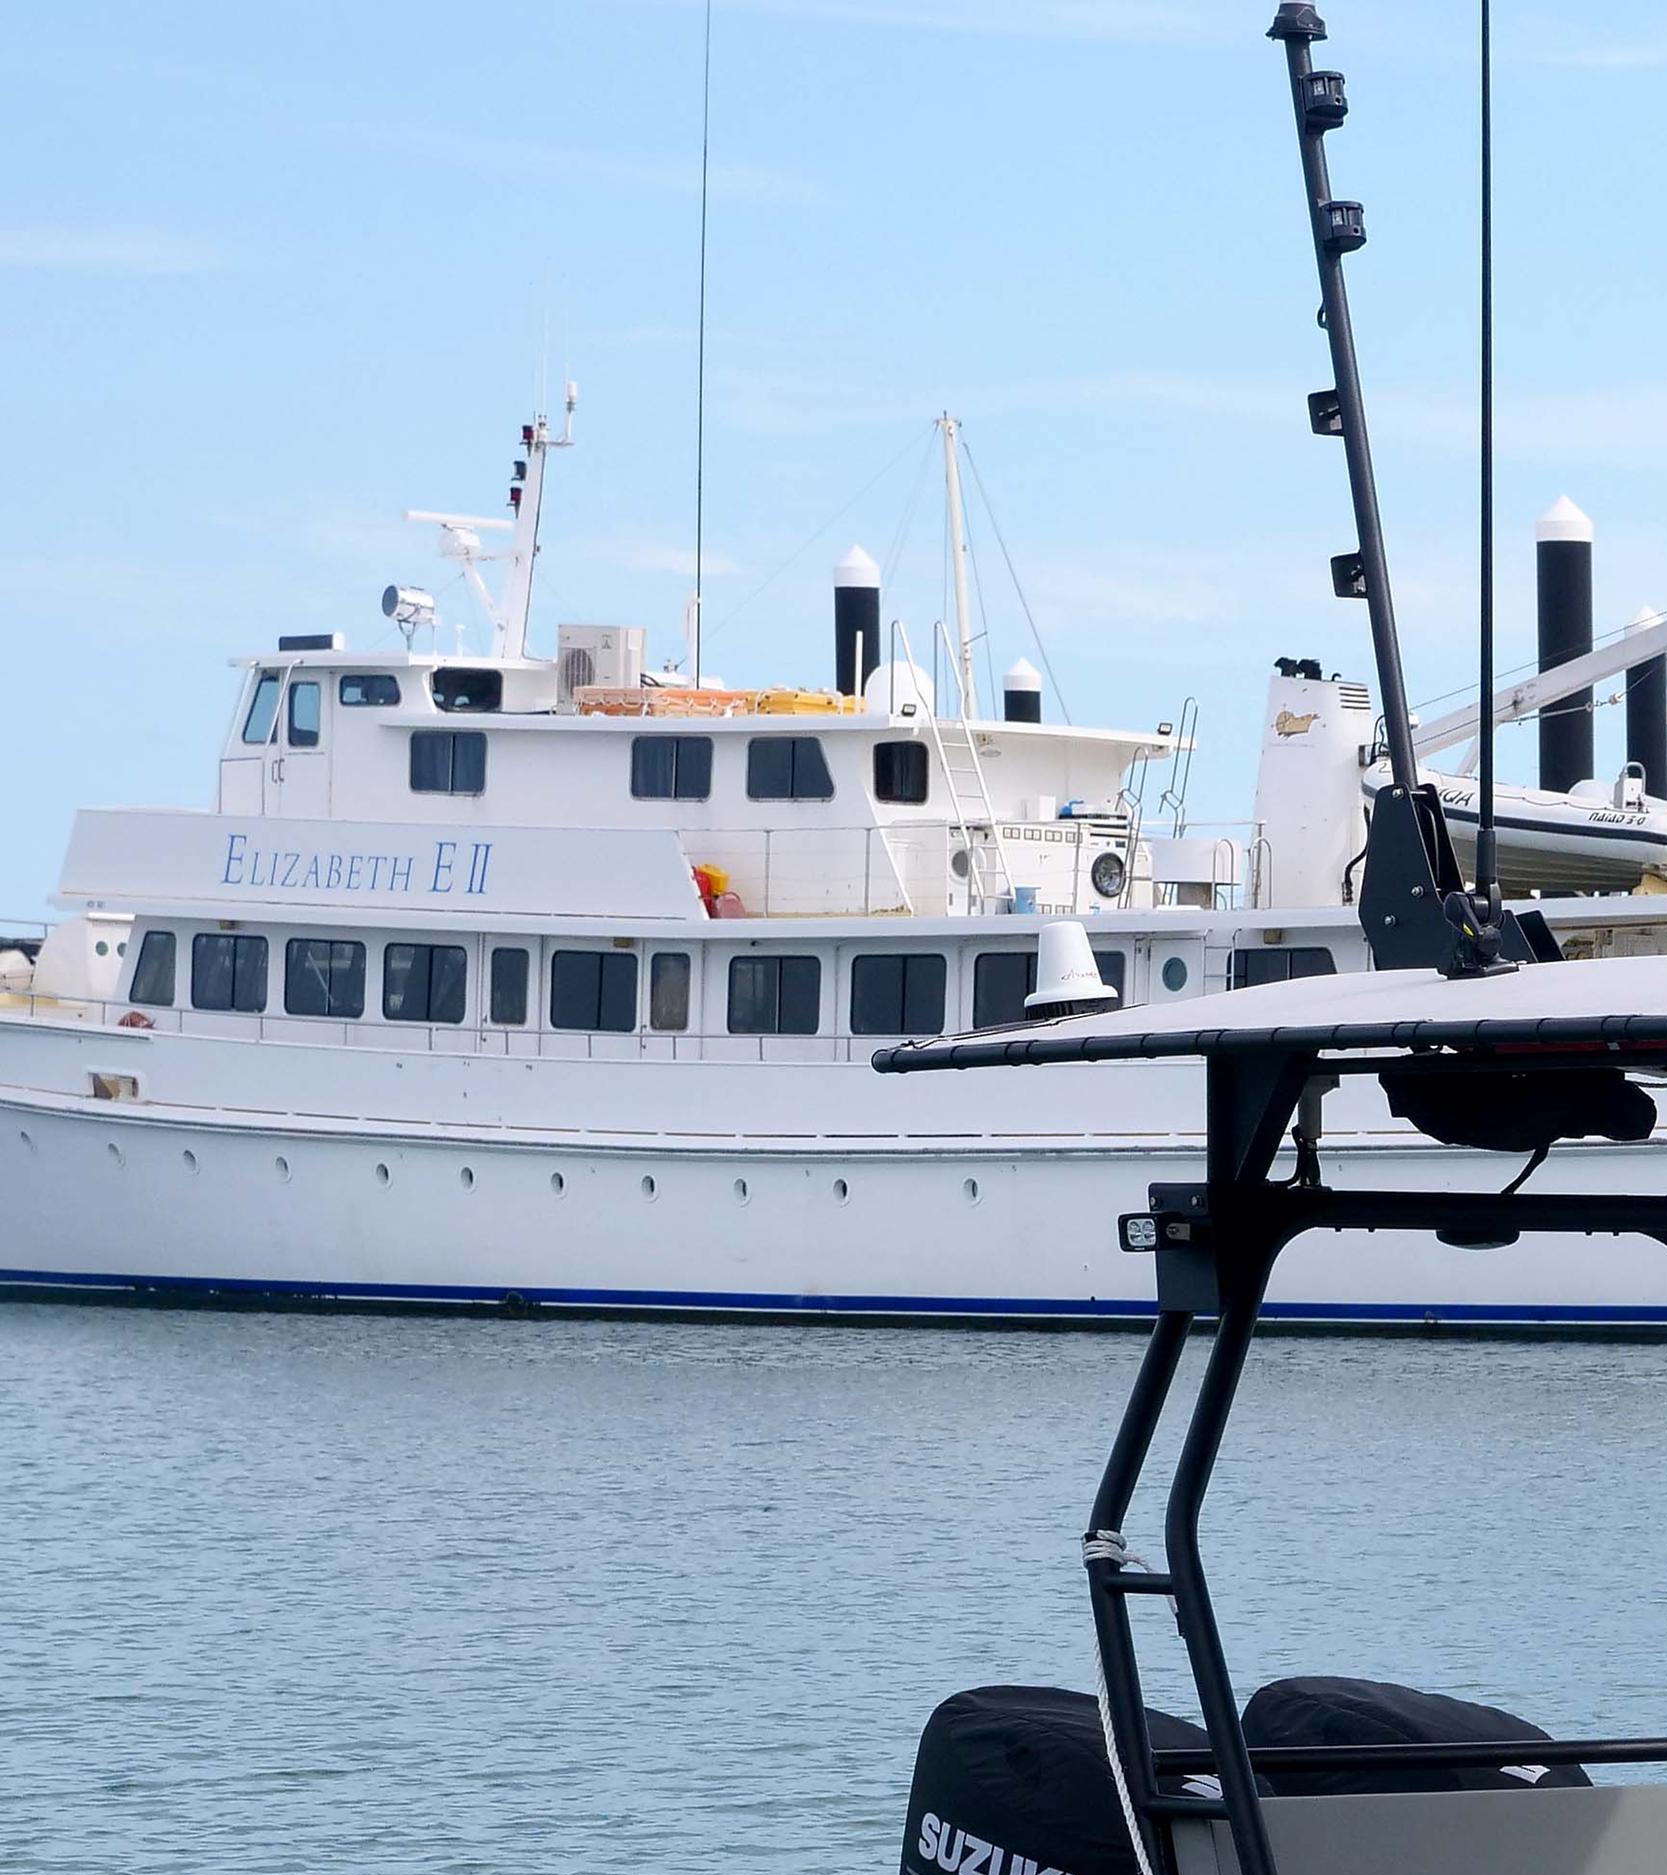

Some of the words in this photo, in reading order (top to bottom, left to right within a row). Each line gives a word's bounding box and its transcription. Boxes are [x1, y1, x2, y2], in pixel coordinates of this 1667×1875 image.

[221, 833, 414, 892] ELIZABETH
[429, 841, 457, 893] E
[464, 843, 493, 895] II
